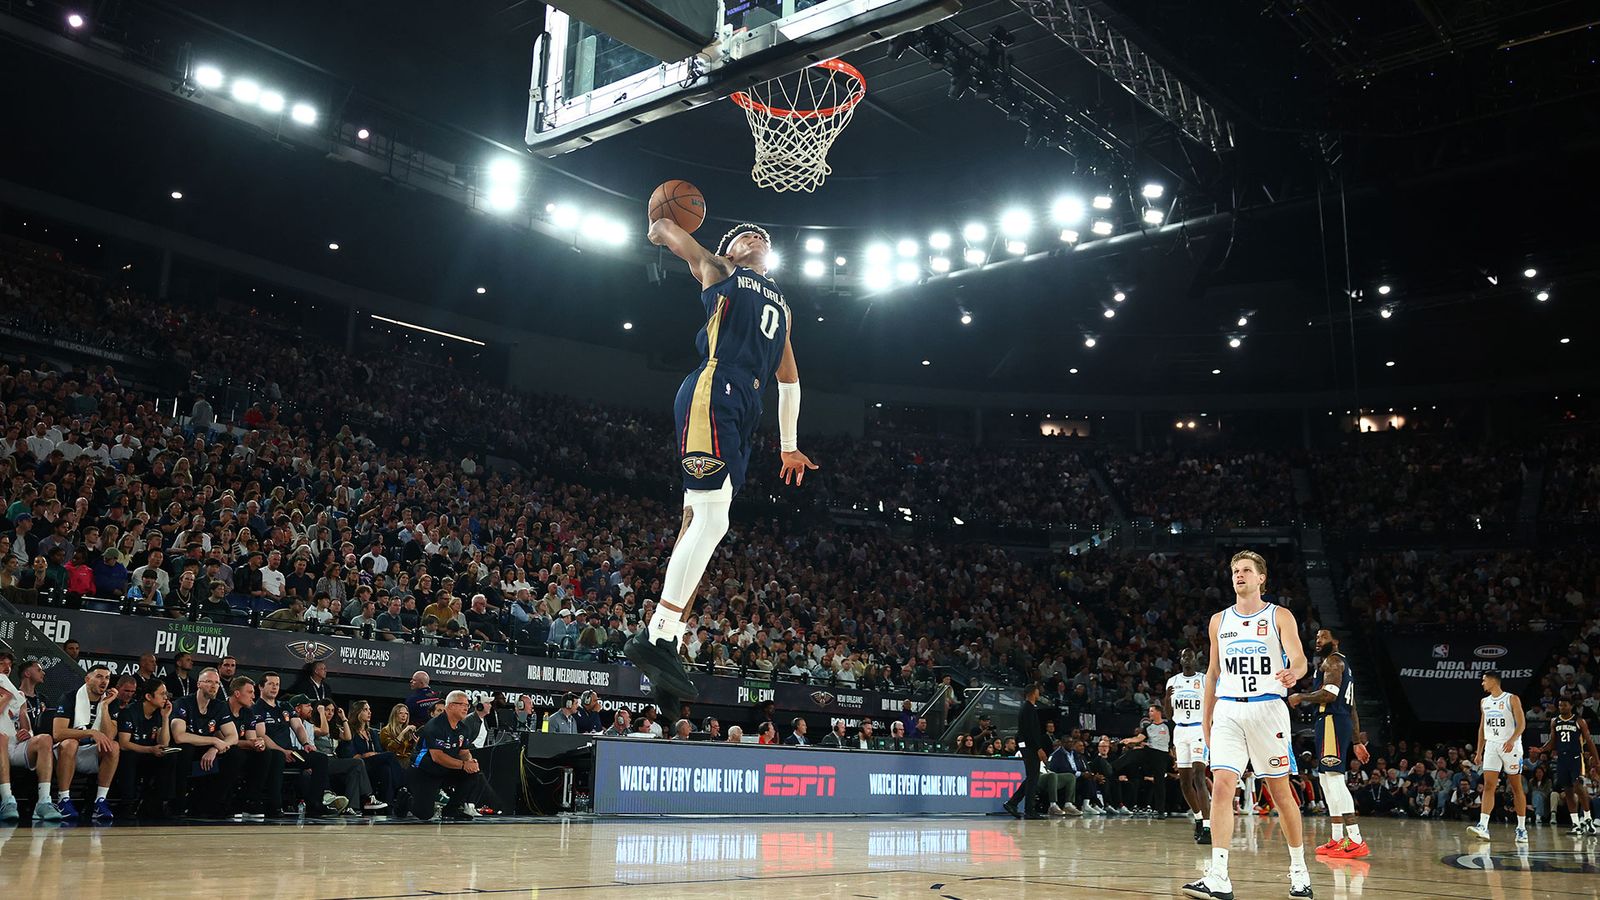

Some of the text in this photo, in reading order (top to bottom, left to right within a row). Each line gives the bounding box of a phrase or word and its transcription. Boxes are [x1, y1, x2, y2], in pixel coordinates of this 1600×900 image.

[737, 276, 761, 292] NEW
[760, 304, 779, 340] 0
[22, 612, 57, 621] BOURNE
[181, 625, 223, 636] MELBOURNE
[340, 646, 390, 662] NEW ORLEANS
[343, 658, 386, 668] PELICANS
[419, 652, 503, 673] MELBOURNE
[1225, 656, 1271, 675] MELB
[1436, 660, 1498, 671] NBA NBL
[528, 665, 610, 687] NBA NBL MELBOURNE SERIES
[1400, 668, 1481, 679] MELBOURNE
[1241, 676, 1257, 692] 12
[597, 699, 637, 713] BOURNE
[1175, 699, 1201, 710] MELB
[1186, 710, 1191, 719] 9
[1486, 718, 1506, 727] MELB
[1560, 731, 1571, 742] 21
[619, 764, 836, 797] WATCH EVERY GAME LIVE ON ESPN
[869, 771, 1022, 798] WATCH EVERY GAME LIVE ON ESPN
